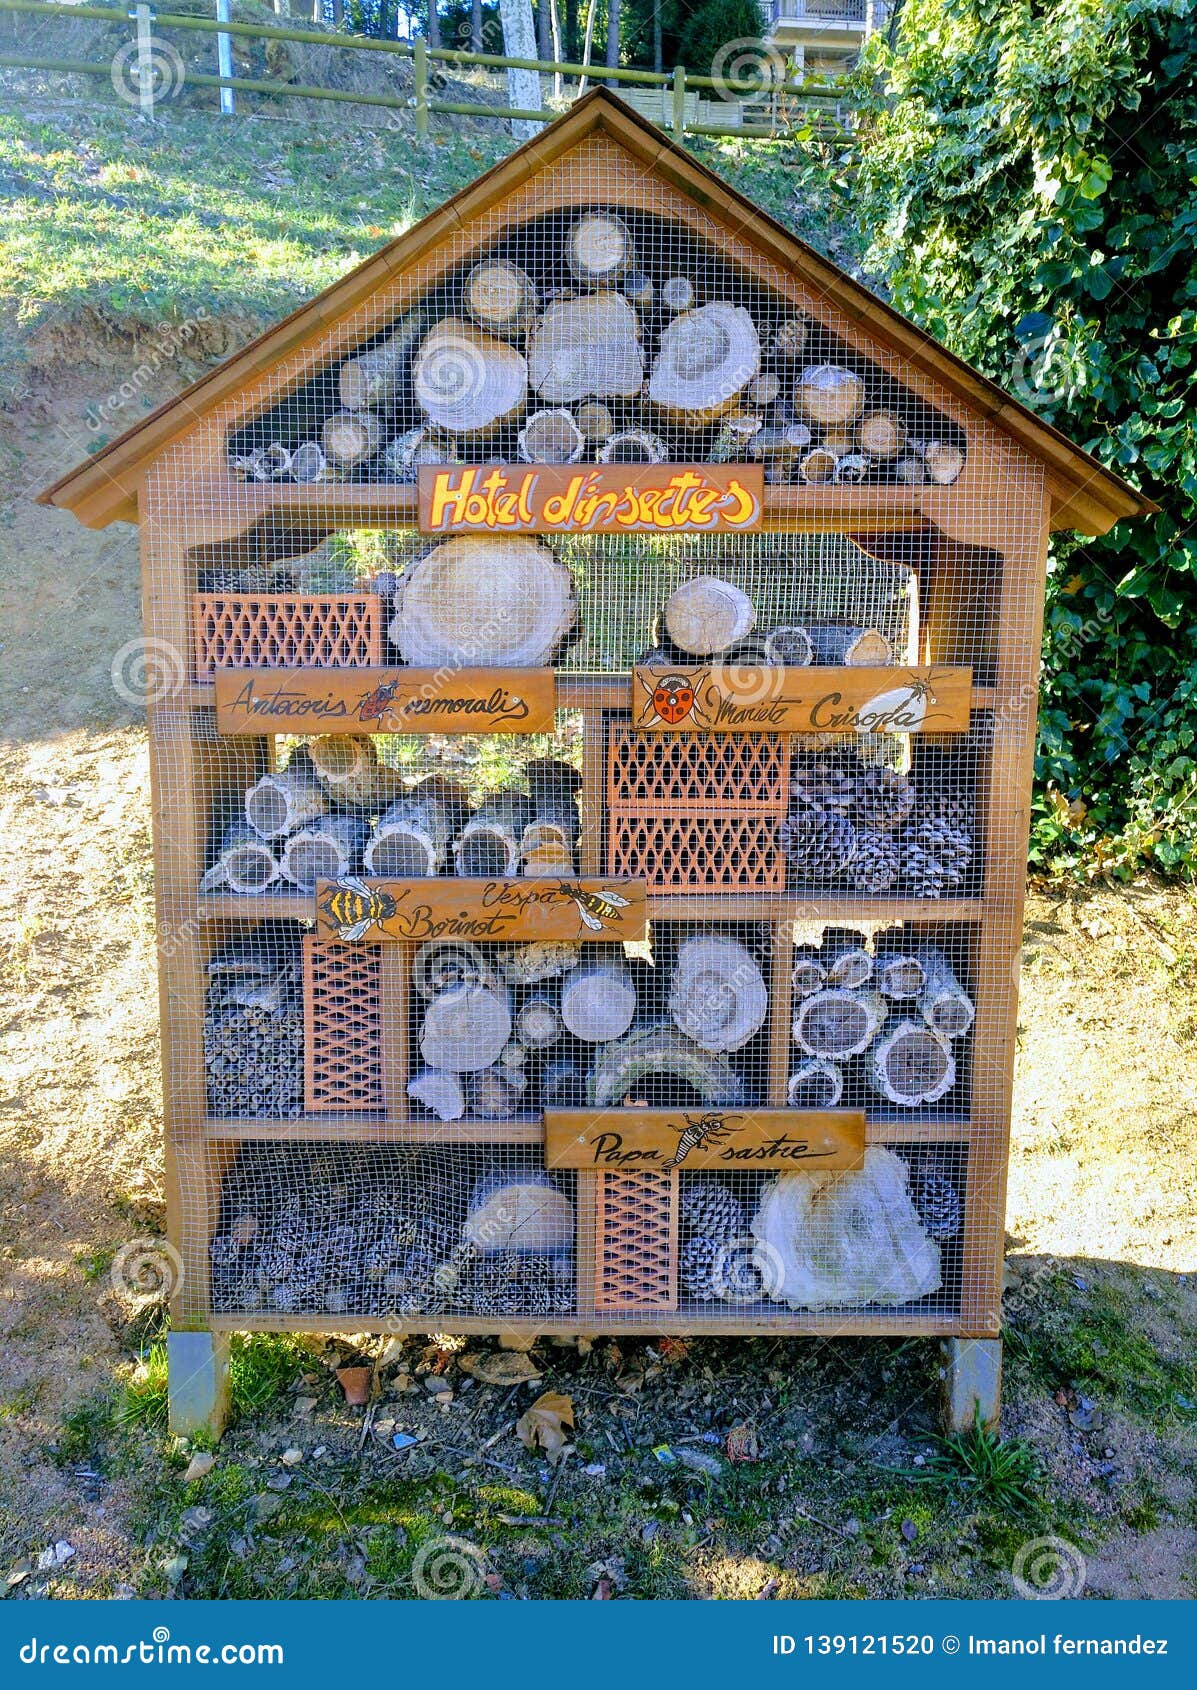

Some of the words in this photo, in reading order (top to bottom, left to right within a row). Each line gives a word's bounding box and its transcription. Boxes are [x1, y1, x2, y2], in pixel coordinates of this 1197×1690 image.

[430, 467, 538, 529] Hotel
[482, 881, 562, 915] Vespa
[400, 905, 517, 938] Borinot
[591, 1133, 664, 1166] Papa
[719, 1133, 836, 1161] sastre
